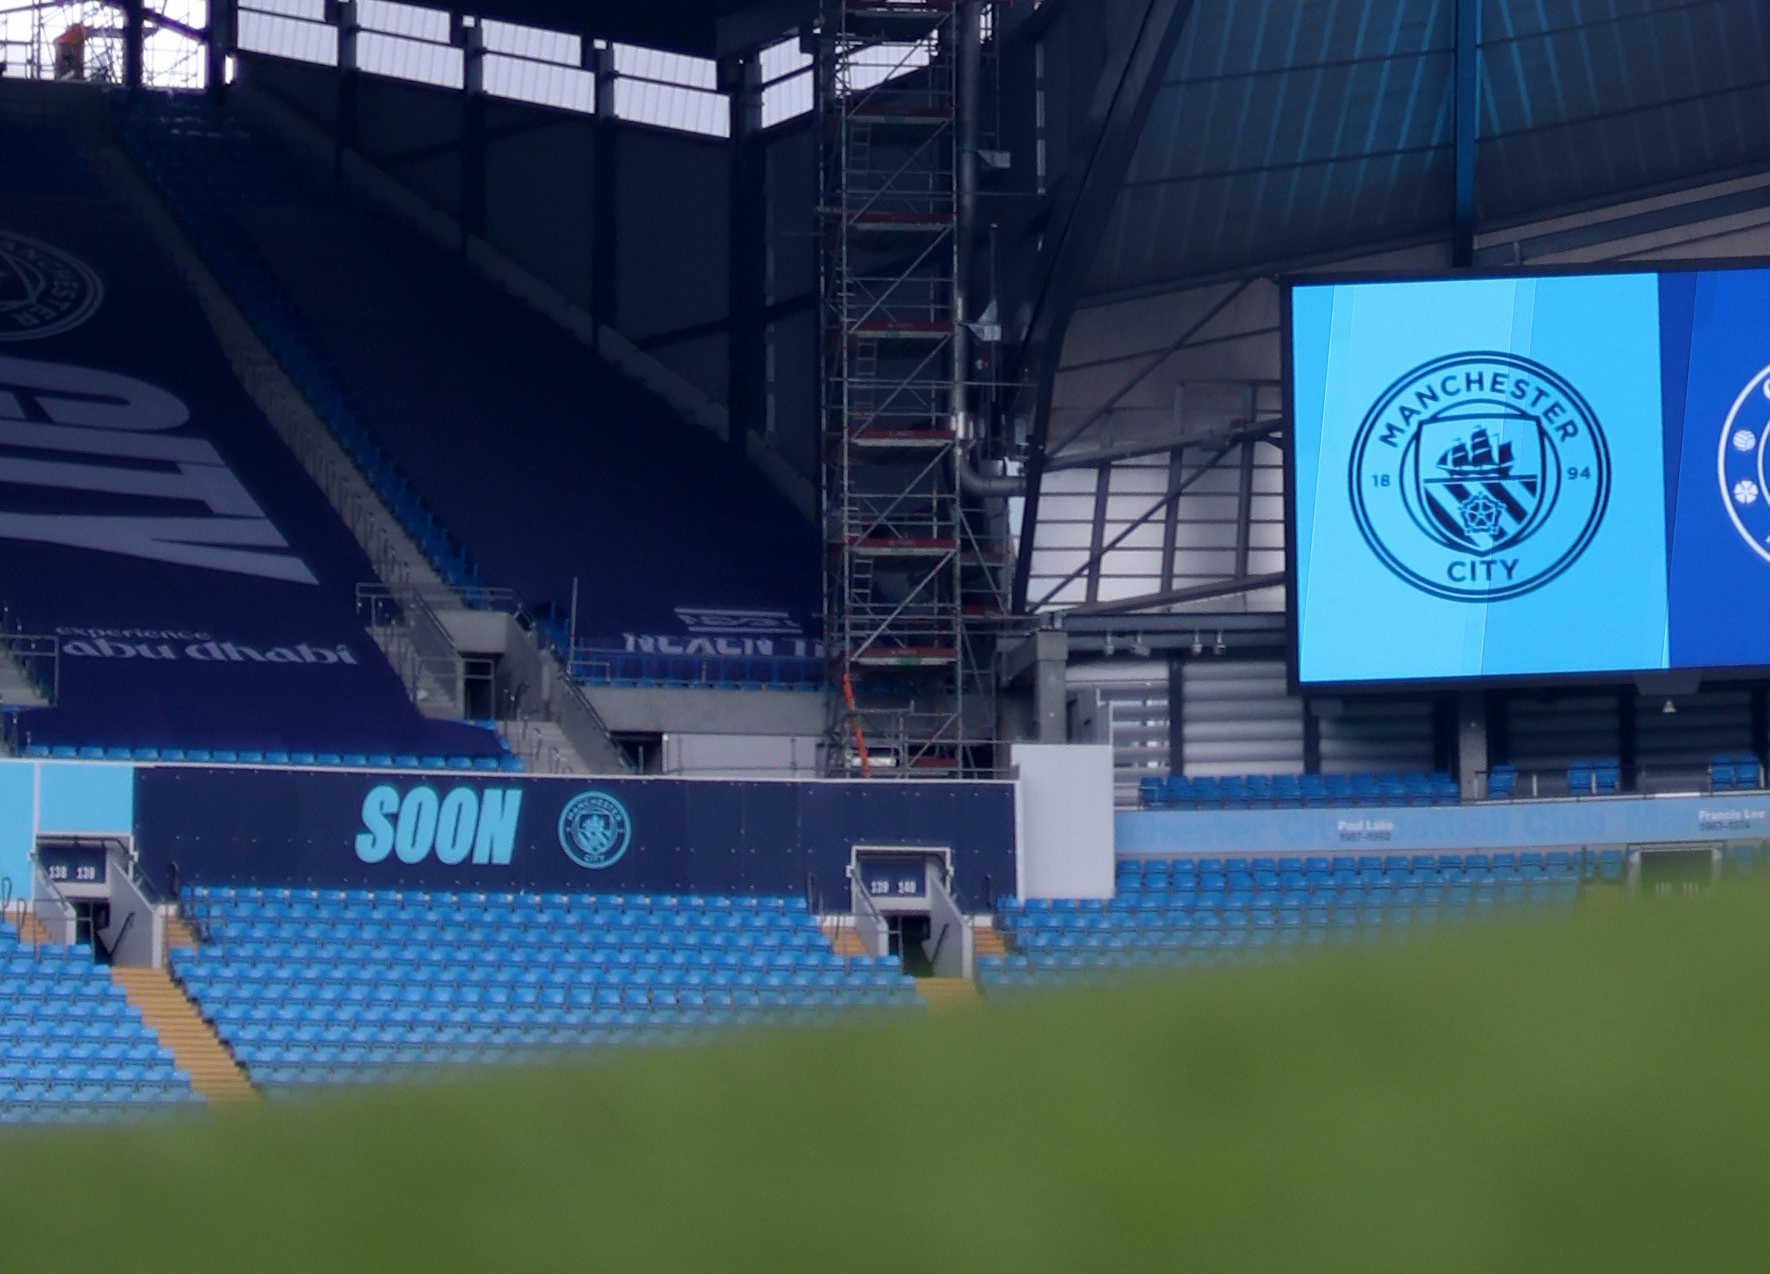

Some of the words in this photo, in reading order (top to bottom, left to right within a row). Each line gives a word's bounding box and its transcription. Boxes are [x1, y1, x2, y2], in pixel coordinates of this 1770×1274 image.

[1378, 371, 1580, 448] MANCHESTER
[1372, 474, 1391, 487] 18
[1567, 466, 1591, 480] 94
[1447, 558, 1520, 583] CITY
[63, 637, 177, 661] abu
[184, 640, 359, 666] dhabi
[355, 785, 522, 865] SOON
